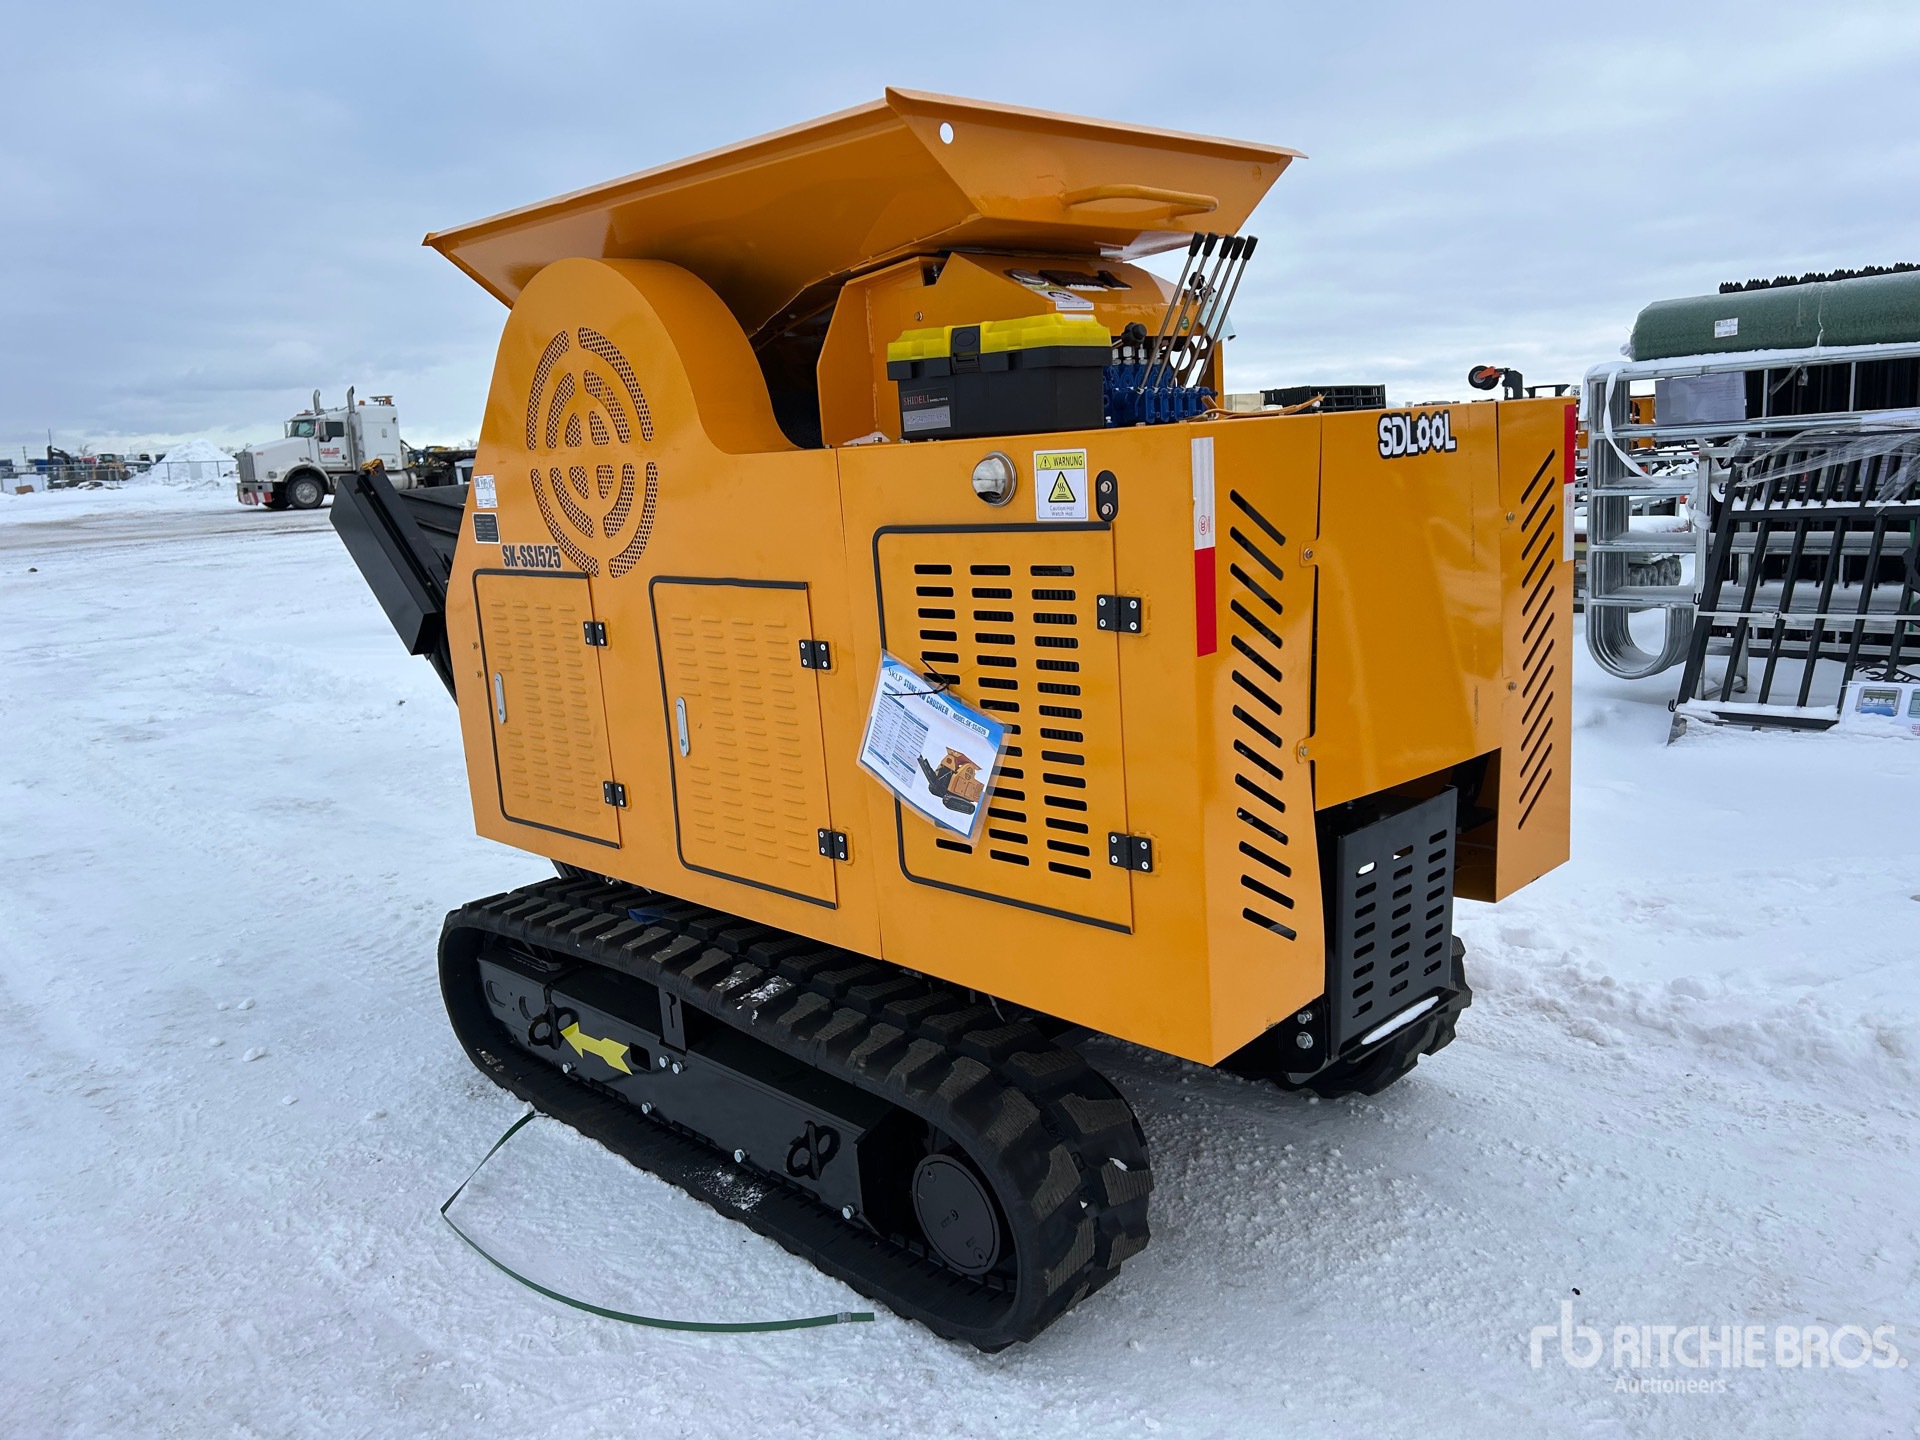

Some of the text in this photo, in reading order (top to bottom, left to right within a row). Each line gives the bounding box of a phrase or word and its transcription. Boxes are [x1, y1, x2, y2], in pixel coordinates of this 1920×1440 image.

[1379, 412, 1456, 457] SDLOOL
[1053, 455, 1083, 467] WARNUNG
[502, 544, 562, 569] SK-SSJ525
